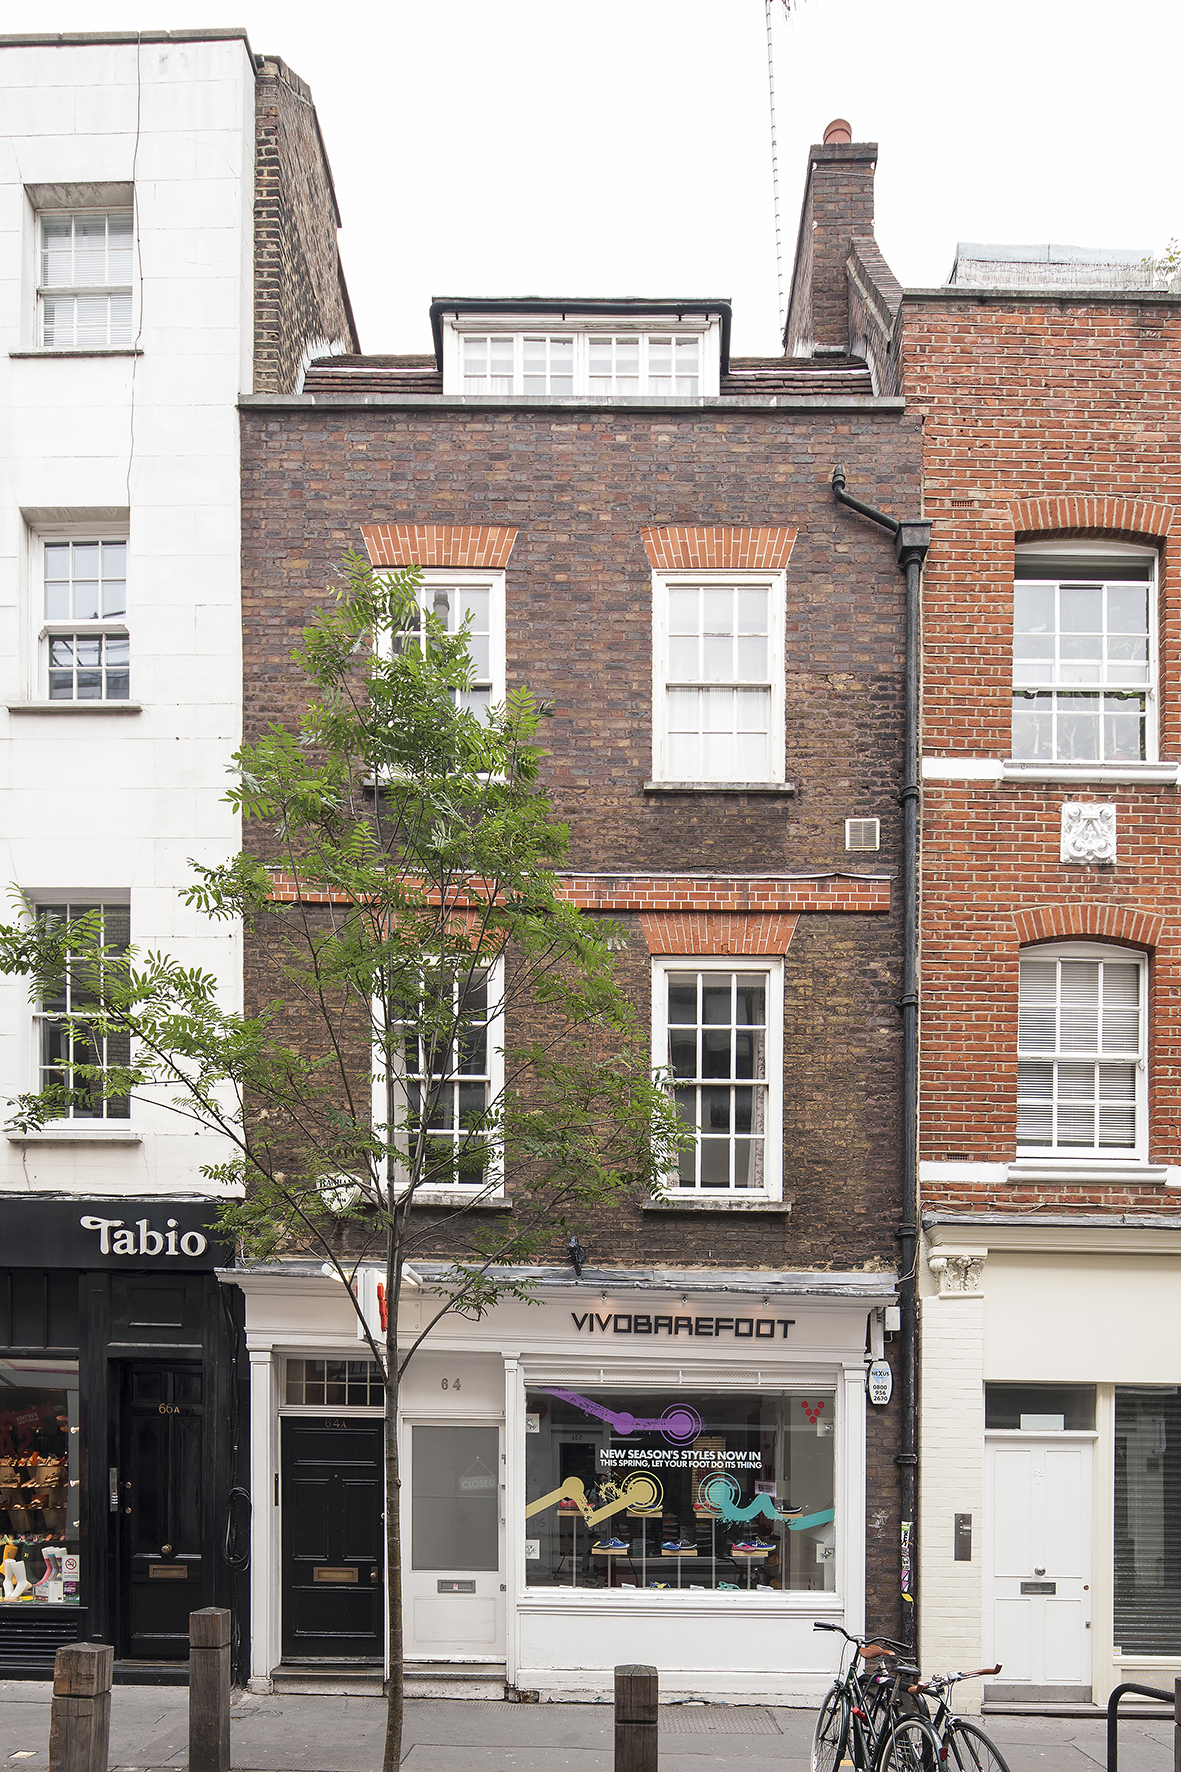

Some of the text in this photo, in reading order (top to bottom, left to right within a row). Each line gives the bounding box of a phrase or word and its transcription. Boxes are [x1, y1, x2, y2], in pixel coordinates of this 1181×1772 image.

[80, 1216, 207, 1257] Tabio
[571, 1313, 795, 1338] VIVOBAREFOOT
[441, 1378, 461, 1390] 64
[159, 1403, 180, 1414] 66A
[325, 1418, 347, 1428] 64A
[600, 1449, 761, 1461] NEW SEASON'S STYLES NOW IN
[600, 1459, 618, 1467] THIS
[618, 1459, 651, 1468] SPRING,
[664, 1460, 688, 1468] YOUR
[725, 1461, 736, 1469] ITS
[736, 1461, 763, 1469] THING
[461, 1479, 496, 1489] CLOSED
